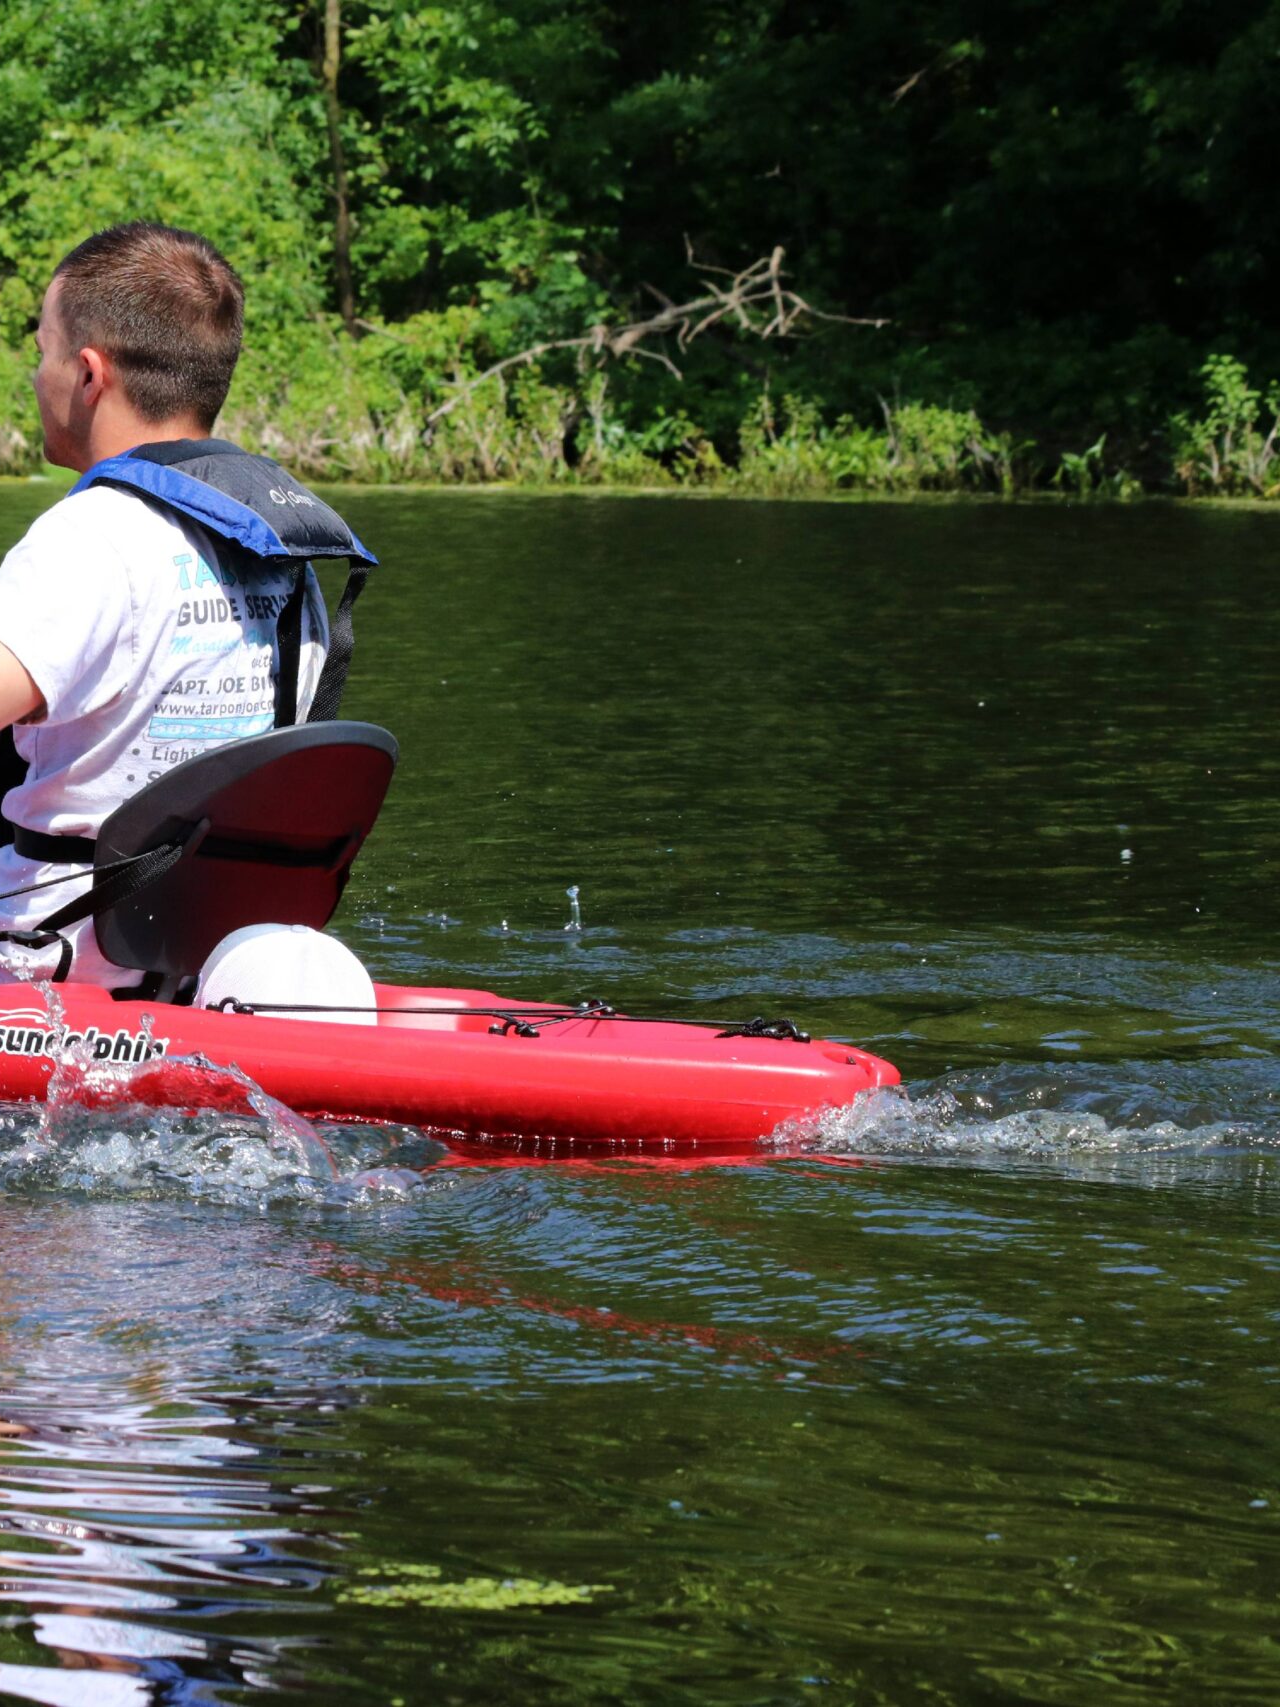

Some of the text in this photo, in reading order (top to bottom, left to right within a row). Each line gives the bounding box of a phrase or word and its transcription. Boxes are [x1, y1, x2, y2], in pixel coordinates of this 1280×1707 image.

[177, 600, 242, 627] GUIDE
[216, 676, 245, 695] JOE
[151, 746, 198, 764] Light
